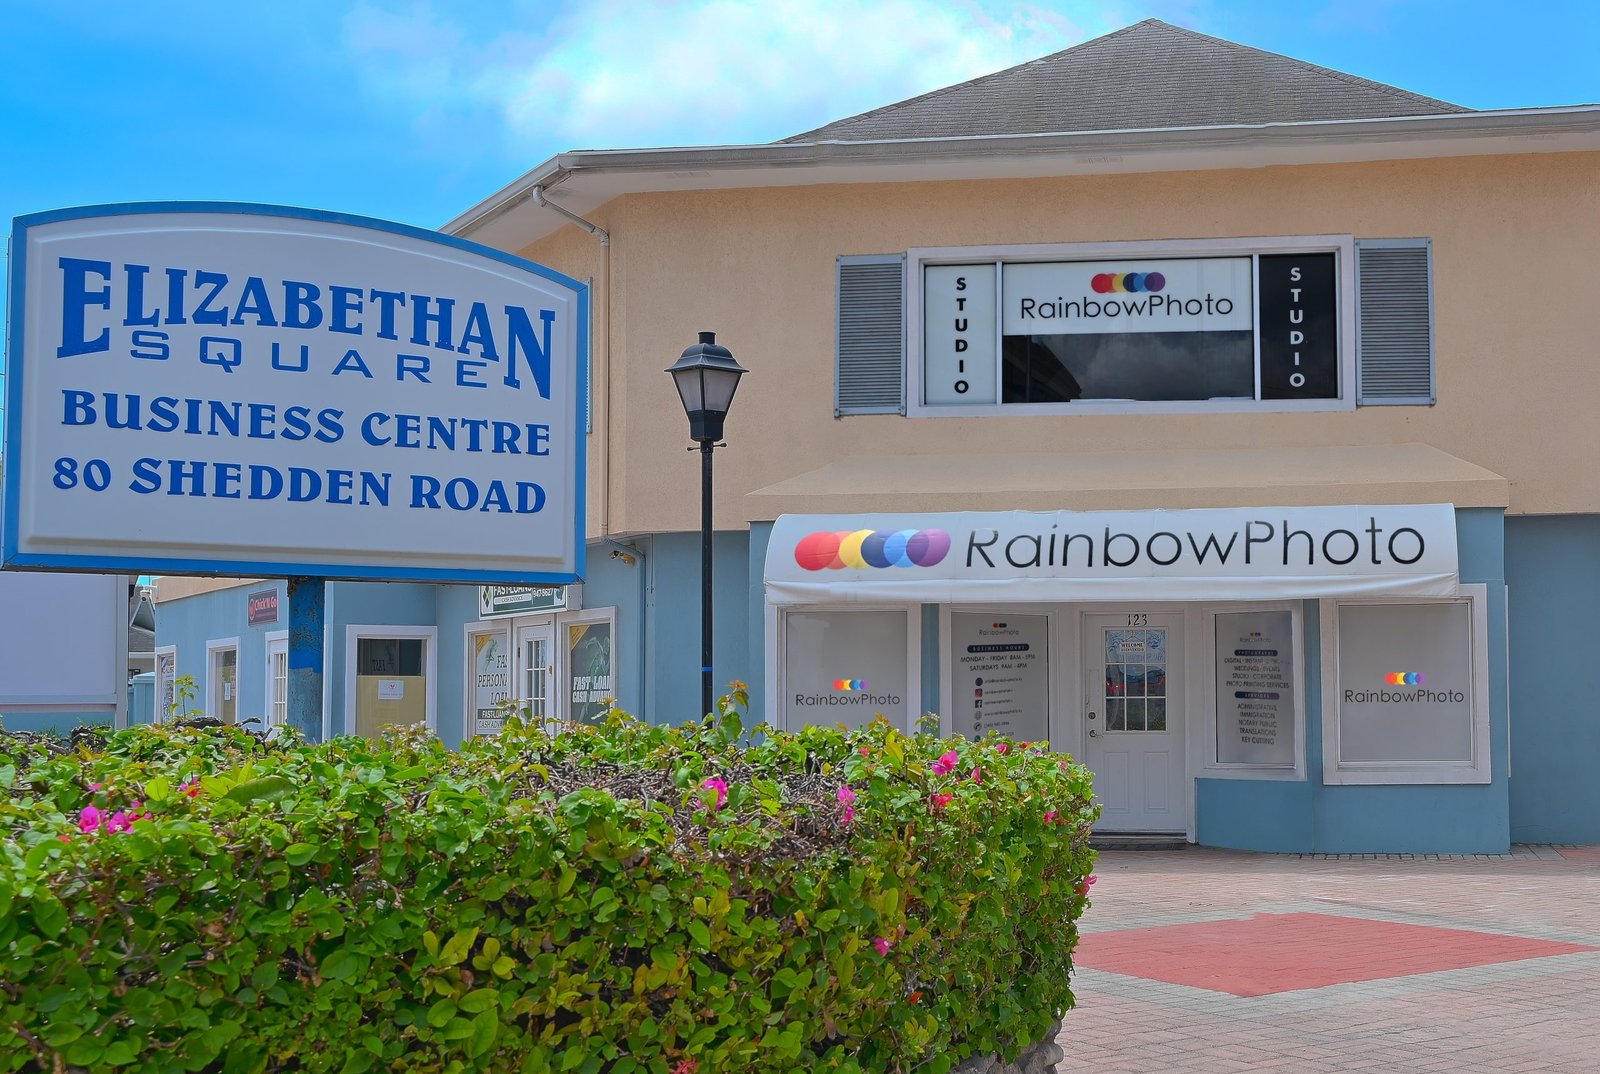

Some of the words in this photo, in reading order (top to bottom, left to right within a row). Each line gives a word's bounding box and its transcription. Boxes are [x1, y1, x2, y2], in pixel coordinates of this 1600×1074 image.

[57, 256, 556, 400] ELIZABETHAN
[1020, 293, 1234, 319] RainbowPhoto
[1290, 267, 1305, 388] STUDIO
[130, 329, 488, 388] SQUARE
[954, 277, 969, 394] STUDIO
[61, 389, 345, 444] BUSINESS
[361, 412, 551, 456] CENTRE
[53, 457, 111, 492] 80
[129, 457, 391, 506] SHEDDEN
[410, 474, 547, 514] ROAD
[966, 517, 1425, 568] RainbowPhoto
[1127, 613, 1148, 626] 123
[573, 676, 591, 690] FAST
[960, 655, 985, 663] MONDAY
[795, 693, 901, 706] RainbowPhoto
[1344, 689, 1465, 703] RainbowPhoto
